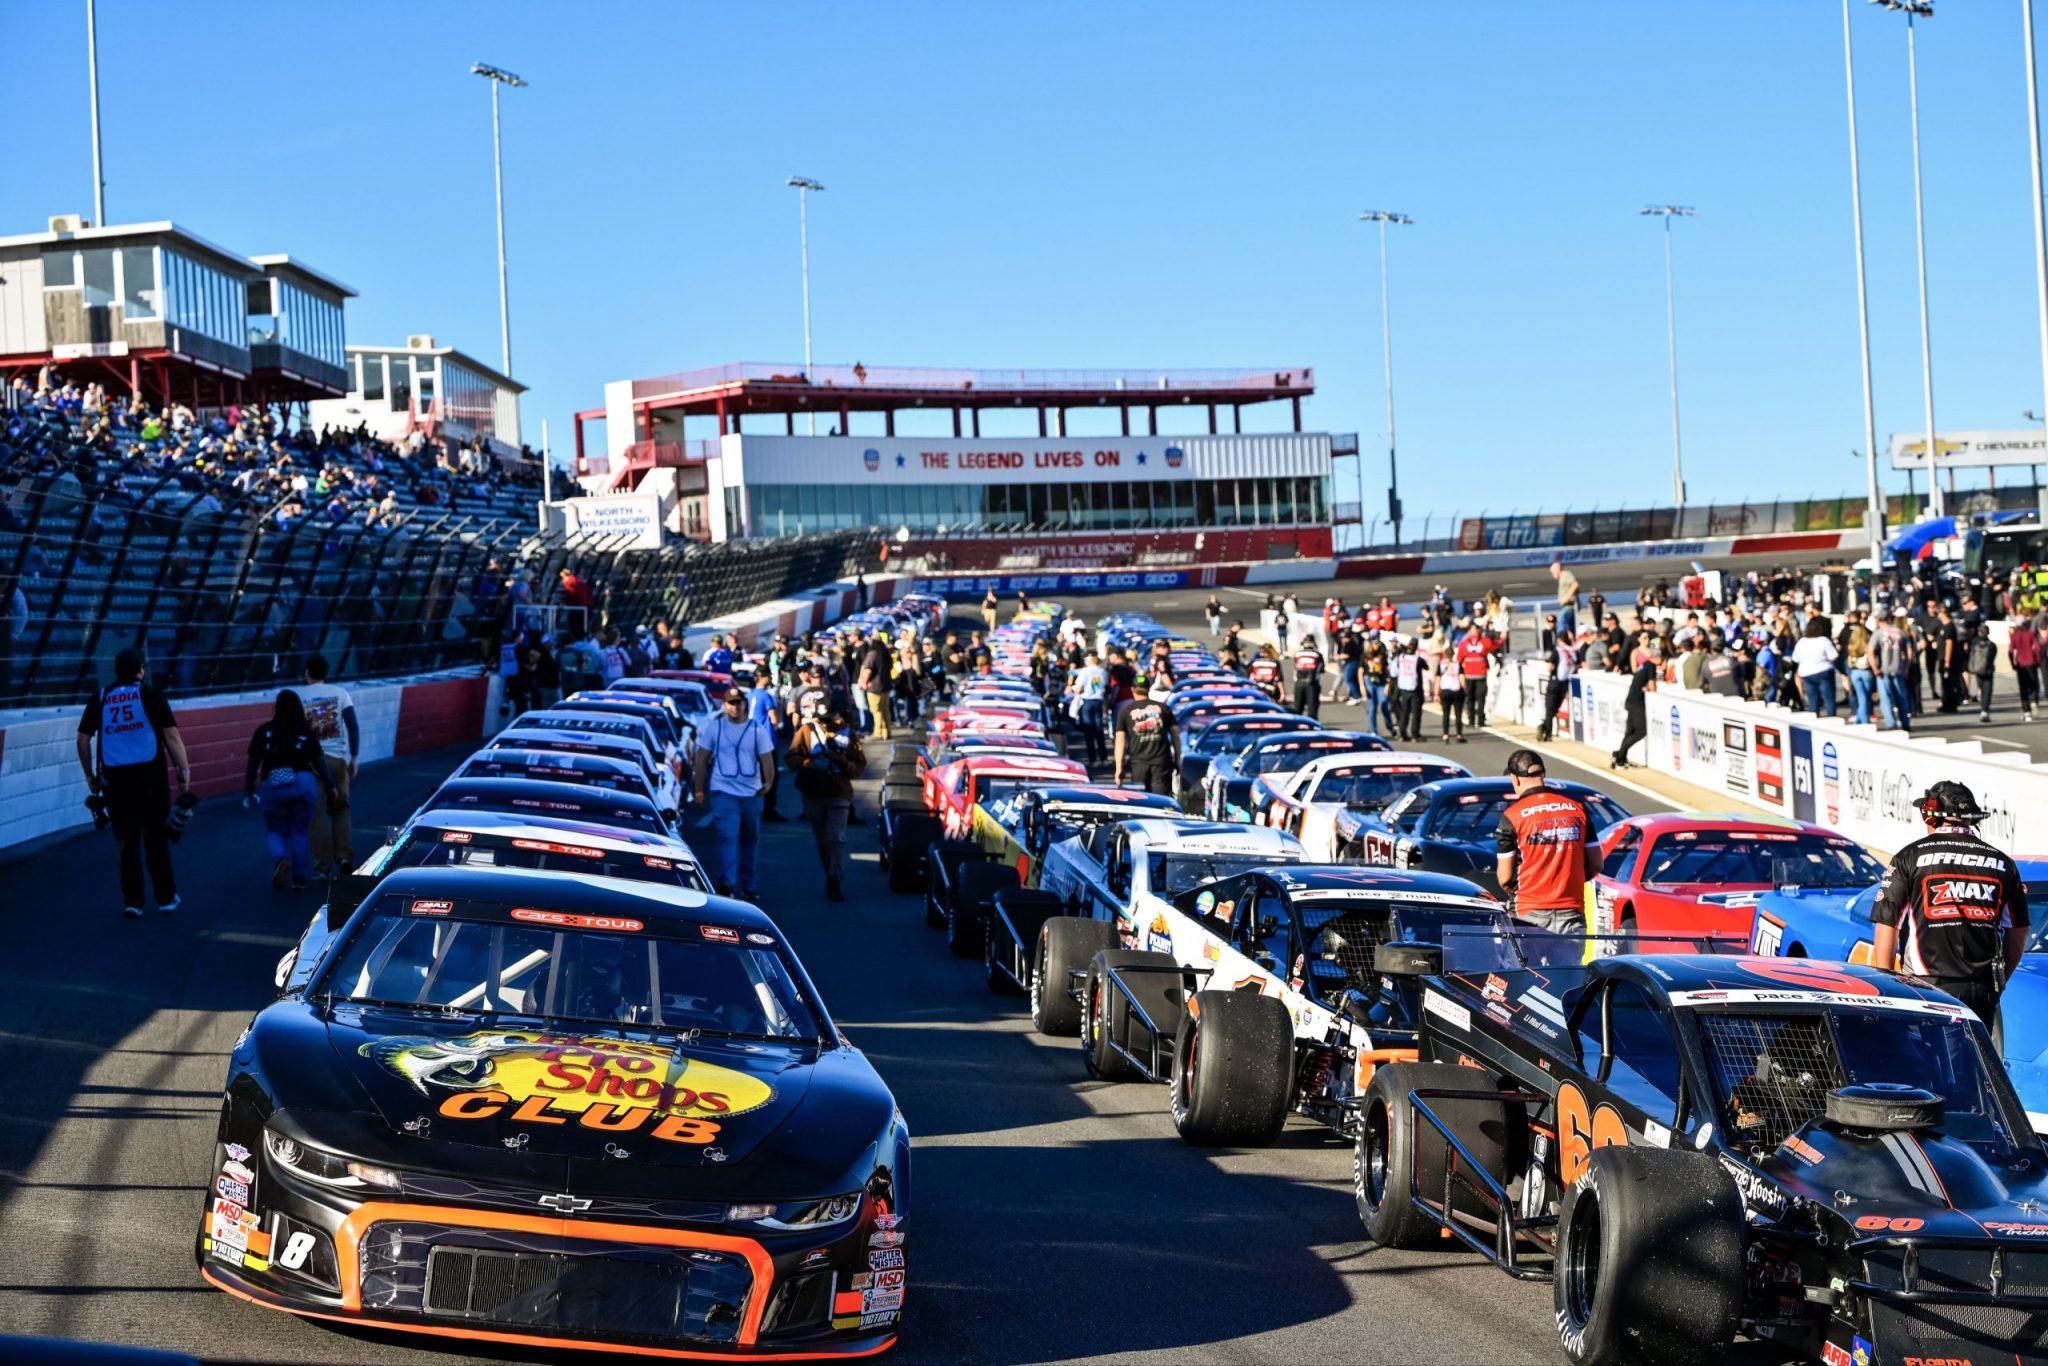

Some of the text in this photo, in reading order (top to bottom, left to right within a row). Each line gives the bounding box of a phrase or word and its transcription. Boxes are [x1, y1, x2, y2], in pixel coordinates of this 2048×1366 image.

[1976, 440, 2046, 451] CHEVROLET
[920, 450, 1120, 469] THE LEGEND LIVES ON
[595, 507, 634, 516] NORTH
[581, 516, 650, 527] WILKESBORO
[1070, 574, 1099, 587] GEICO
[1105, 573, 1137, 586] GEICO
[1144, 572, 1178, 585] GEICO
[109, 704, 134, 723] 75
[1520, 802, 1577, 818] OFFICIAL
[563, 846, 602, 858] TOUR
[1916, 852, 2006, 872] OFFICIAL
[1347, 890, 1382, 899] pace
[581, 917, 640, 930] TOUR
[1755, 992, 1893, 1007] pace matic
[536, 1046, 657, 1073] Pro
[535, 1062, 731, 1113] Shops
[437, 1090, 727, 1145] CLUB
[219, 1178, 247, 1194] QUARTER
[1745, 1175, 1787, 1211] Hoosier
[225, 1188, 247, 1203] MASTER
[216, 1200, 241, 1221] MSD
[1854, 1215, 1926, 1232] 60
[279, 1231, 316, 1270] 8
[870, 1249, 901, 1265] QUARTER
[875, 1258, 903, 1270] MASTER
[876, 1271, 904, 1288] MSD
[861, 1311, 897, 1326] VICTORY
